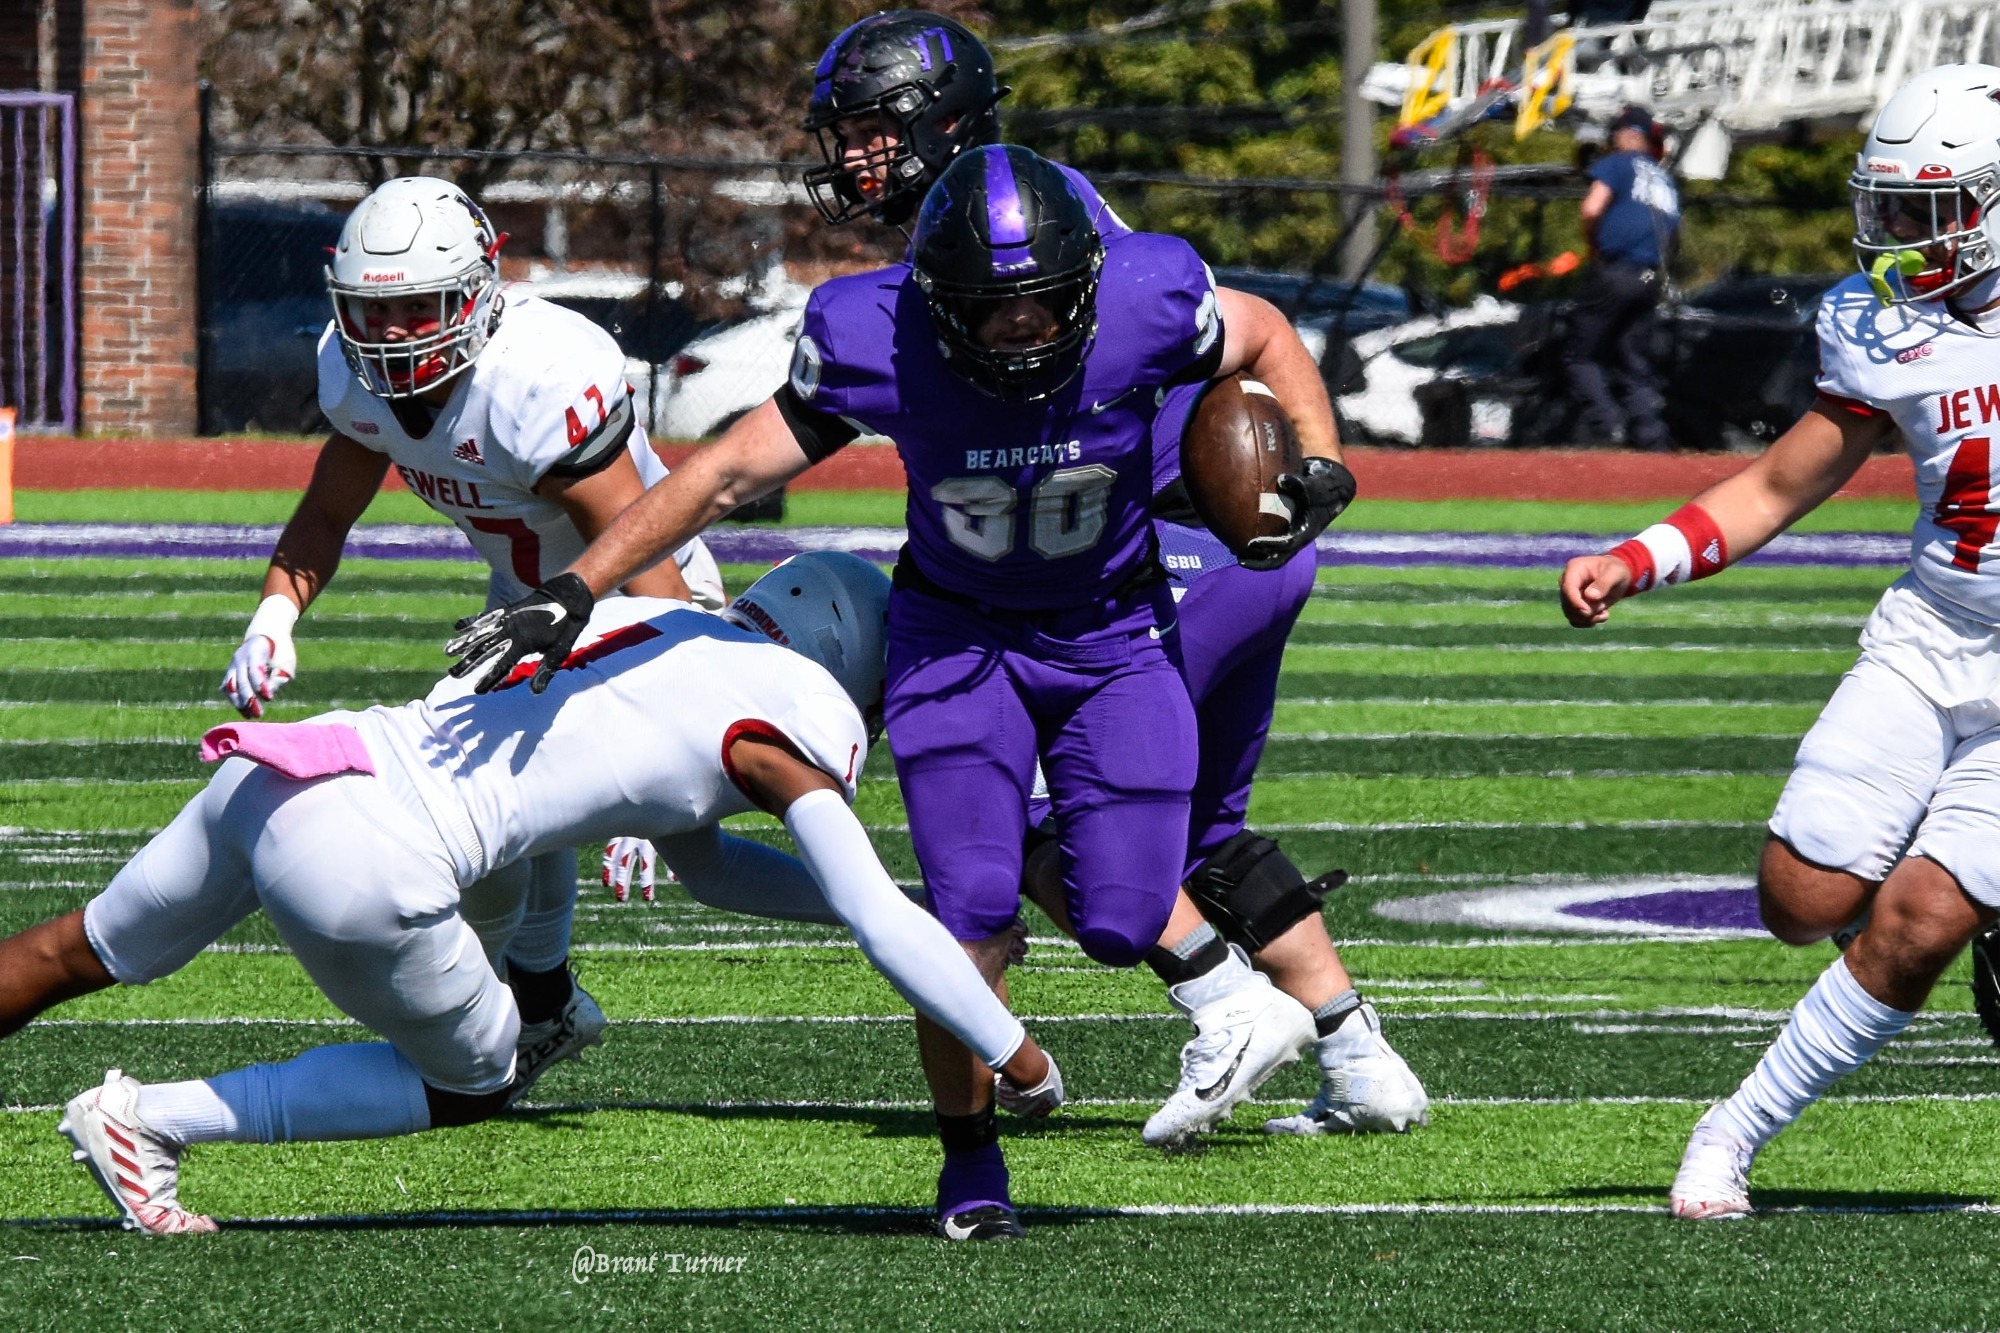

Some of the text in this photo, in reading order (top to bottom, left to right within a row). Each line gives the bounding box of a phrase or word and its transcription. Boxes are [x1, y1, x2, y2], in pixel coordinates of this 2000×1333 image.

[565, 383, 606, 449] 47
[966, 440, 1081, 469] BEARCATS
[931, 464, 1118, 562] 30
[1166, 554, 1202, 569] SBU
